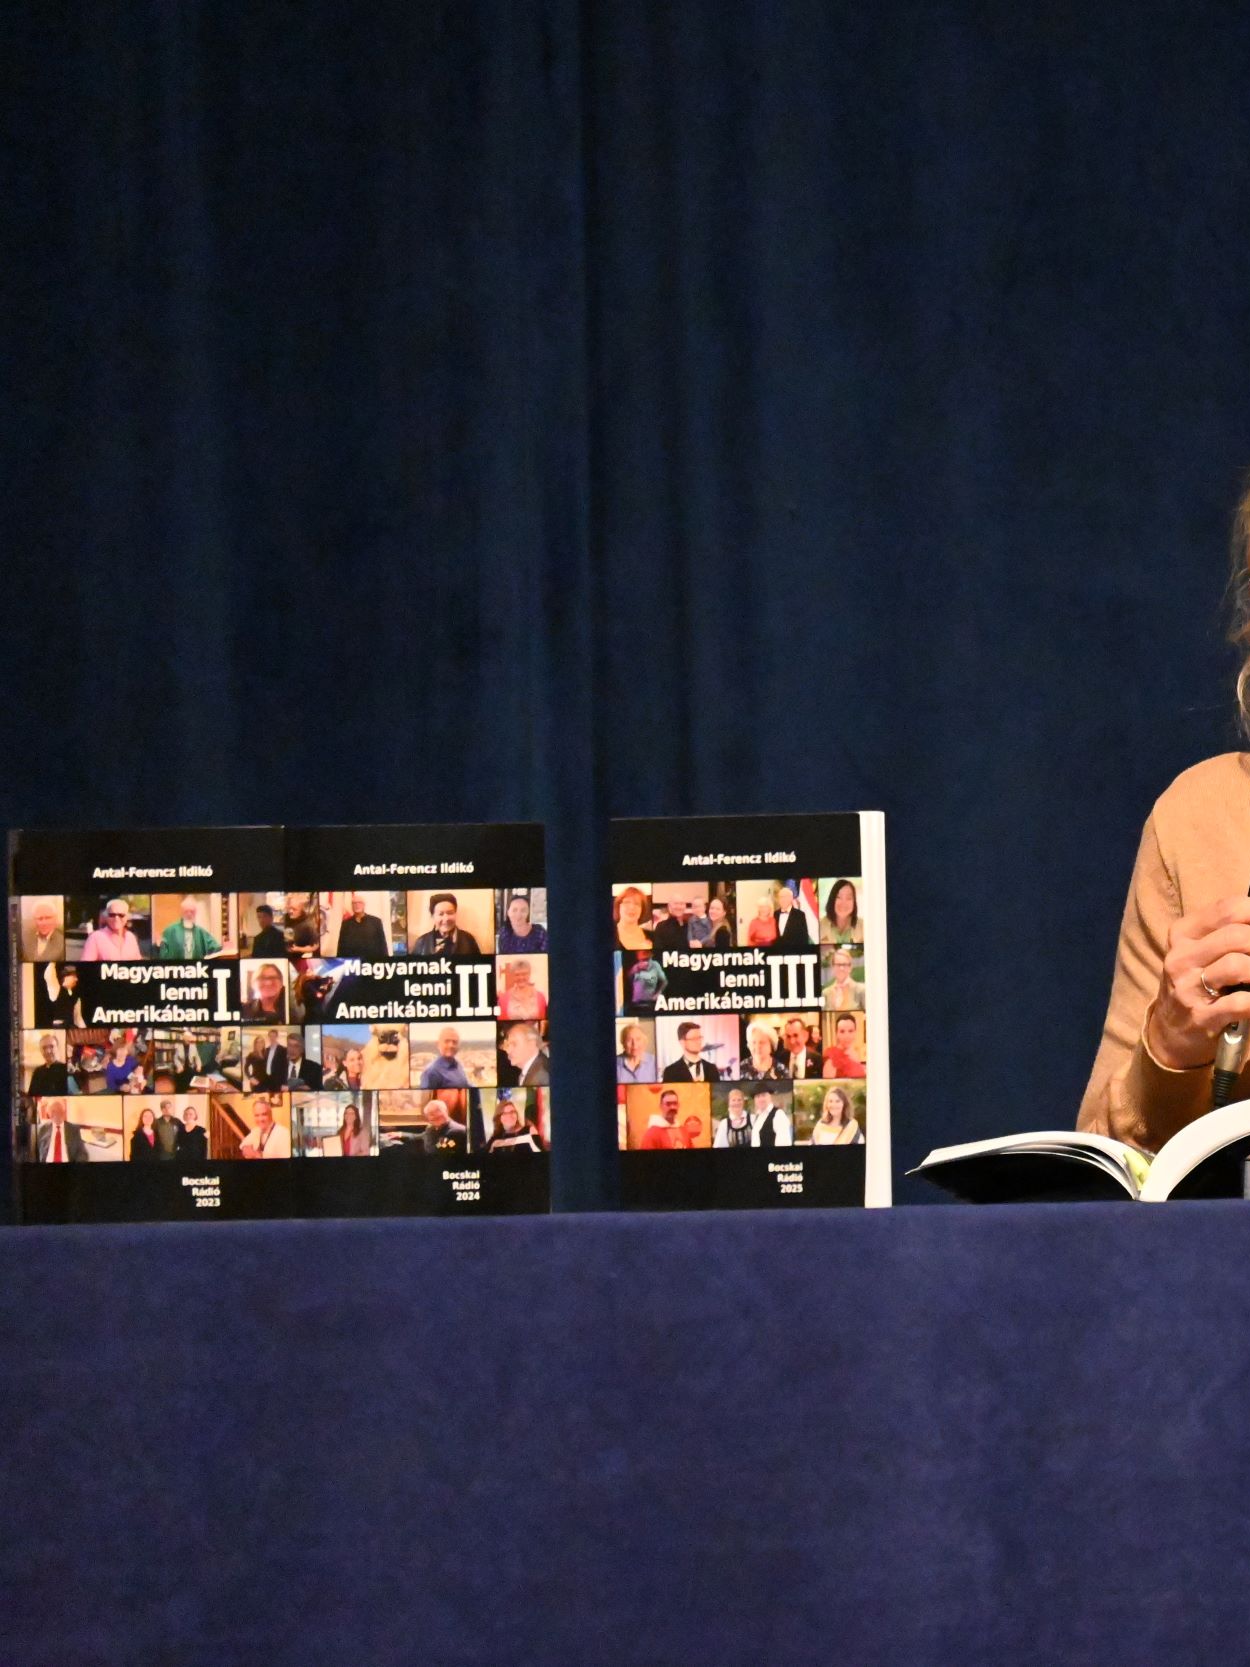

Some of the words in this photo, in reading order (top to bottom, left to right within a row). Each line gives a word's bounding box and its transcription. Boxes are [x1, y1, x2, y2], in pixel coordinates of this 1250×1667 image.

[682, 853, 762, 866] Antal-Ferencz
[764, 851, 797, 863] Ildikó
[93, 866, 176, 879] Antal-Ferencz
[178, 865, 213, 877] Ildikó
[353, 863, 438, 876] Antal-Ferencz
[440, 861, 475, 874] Ildikó
[344, 958, 452, 979] Magyarnak
[662, 948, 766, 971] Magyarnak
[101, 962, 209, 984] Magyarnak
[719, 969, 766, 988] lenni
[766, 954, 826, 1008] III.
[160, 983, 208, 1001] lenni
[212, 969, 241, 1022] I.
[404, 979, 452, 997] lenni
[455, 964, 501, 1017] II.
[335, 1000, 452, 1019] Amerikában
[654, 991, 766, 1011] Amerikában
[92, 1003, 209, 1024] Amerikában
[182, 1175, 220, 1186] Bocskai
[442, 1170, 480, 1180] Bocskai
[452, 1180, 480, 1190] Rádió
[780, 1183, 804, 1194] 2025
[195, 1197, 221, 1207] 2023
[456, 1191, 480, 1201] 2024
